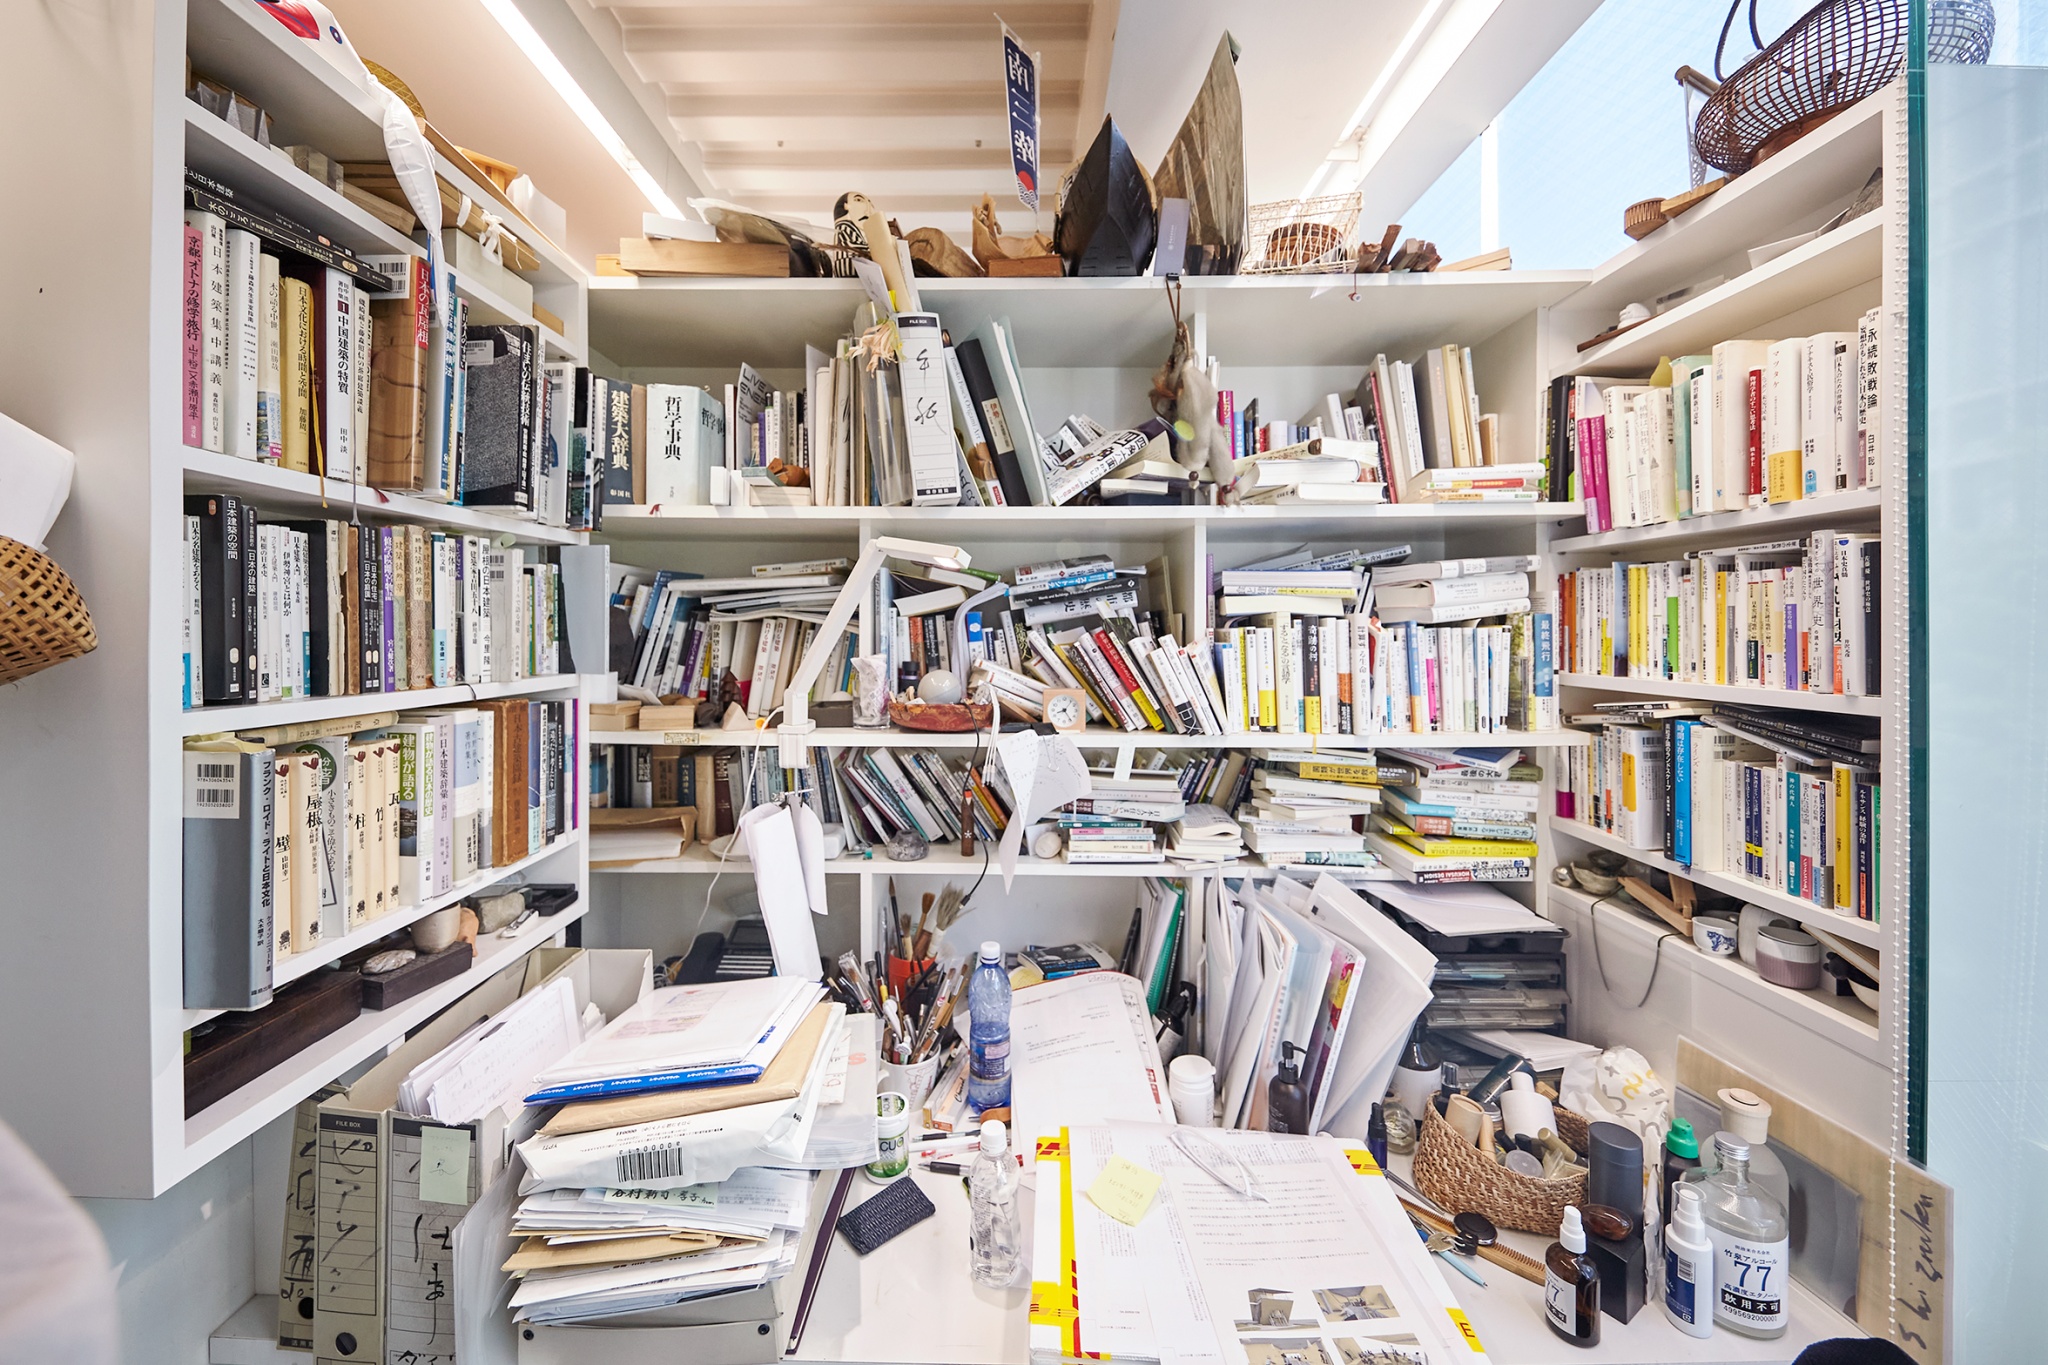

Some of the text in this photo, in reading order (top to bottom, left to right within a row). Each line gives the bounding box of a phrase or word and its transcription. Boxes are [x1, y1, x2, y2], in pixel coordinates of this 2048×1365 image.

[186, 235, 201, 341] 京都、オトナの修学旅行
[210, 245, 222, 386] 日本建築集中講義
[298, 286, 308, 399] 日本文化における時間と空間
[337, 315, 349, 395] 中国建築の特質
[742, 368, 766, 393] LIVE
[1867, 328, 1878, 409] 永続敗戦論
[611, 390, 630, 471] 建築大辞典
[664, 396, 682, 461] 哲学事典
[964, 400, 976, 427] Origami
[1868, 434, 1876, 466] 白井聡
[227, 500, 238, 560] 日本建築の空間
[283, 551, 292, 616] 伊勢神宮とは何か
[1541, 620, 1550, 662] 最終飛行
[402, 733, 417, 800] 建物が語る
[424, 731, 434, 817] 建物が語る日本の歴史
[306, 794, 322, 829] 屋根
[355, 813, 366, 831] 柱
[375, 807, 385, 823] 竹
[261, 761, 272, 907] フランク・ロイド・ライトと日本文化
[275, 835, 290, 854] 壁
[349, 1121, 361, 1129] BOX
[1724, 1248, 1778, 1265] 竹泉アルコール
[1733, 1260, 1772, 1292] 77
[1724, 1282, 1779, 1299] 高濃度エタノール
[1724, 1292, 1779, 1312] 飲用不可
